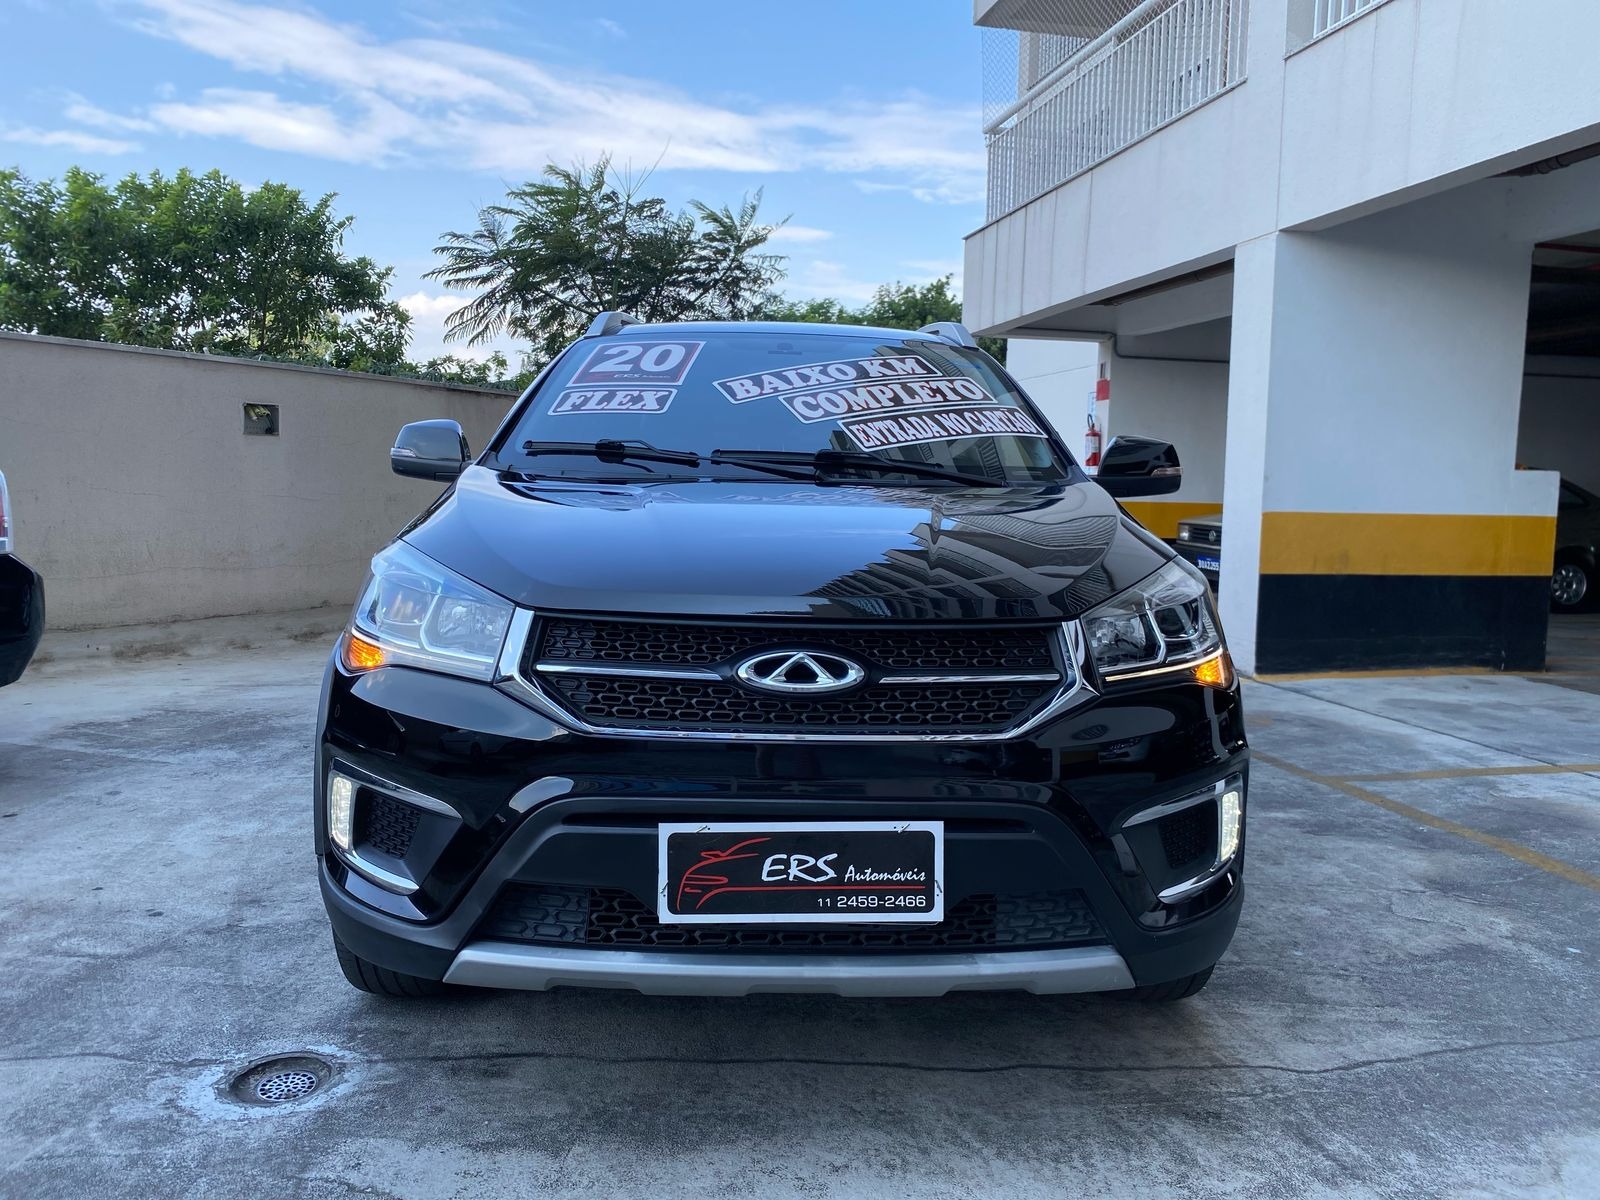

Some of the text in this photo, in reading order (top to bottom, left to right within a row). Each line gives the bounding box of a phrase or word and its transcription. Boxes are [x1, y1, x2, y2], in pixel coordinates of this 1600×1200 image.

[589, 344, 686, 372] 20
[726, 358, 927, 400] BAIXO KM
[556, 390, 669, 412] FLEX
[793, 379, 984, 418] COMPLETO
[849, 414, 948, 447] ENTRADA
[934, 412, 973, 436] NO
[761, 853, 926, 883] ERS Automóveis
[817, 895, 926, 908] 11 2459-2466
